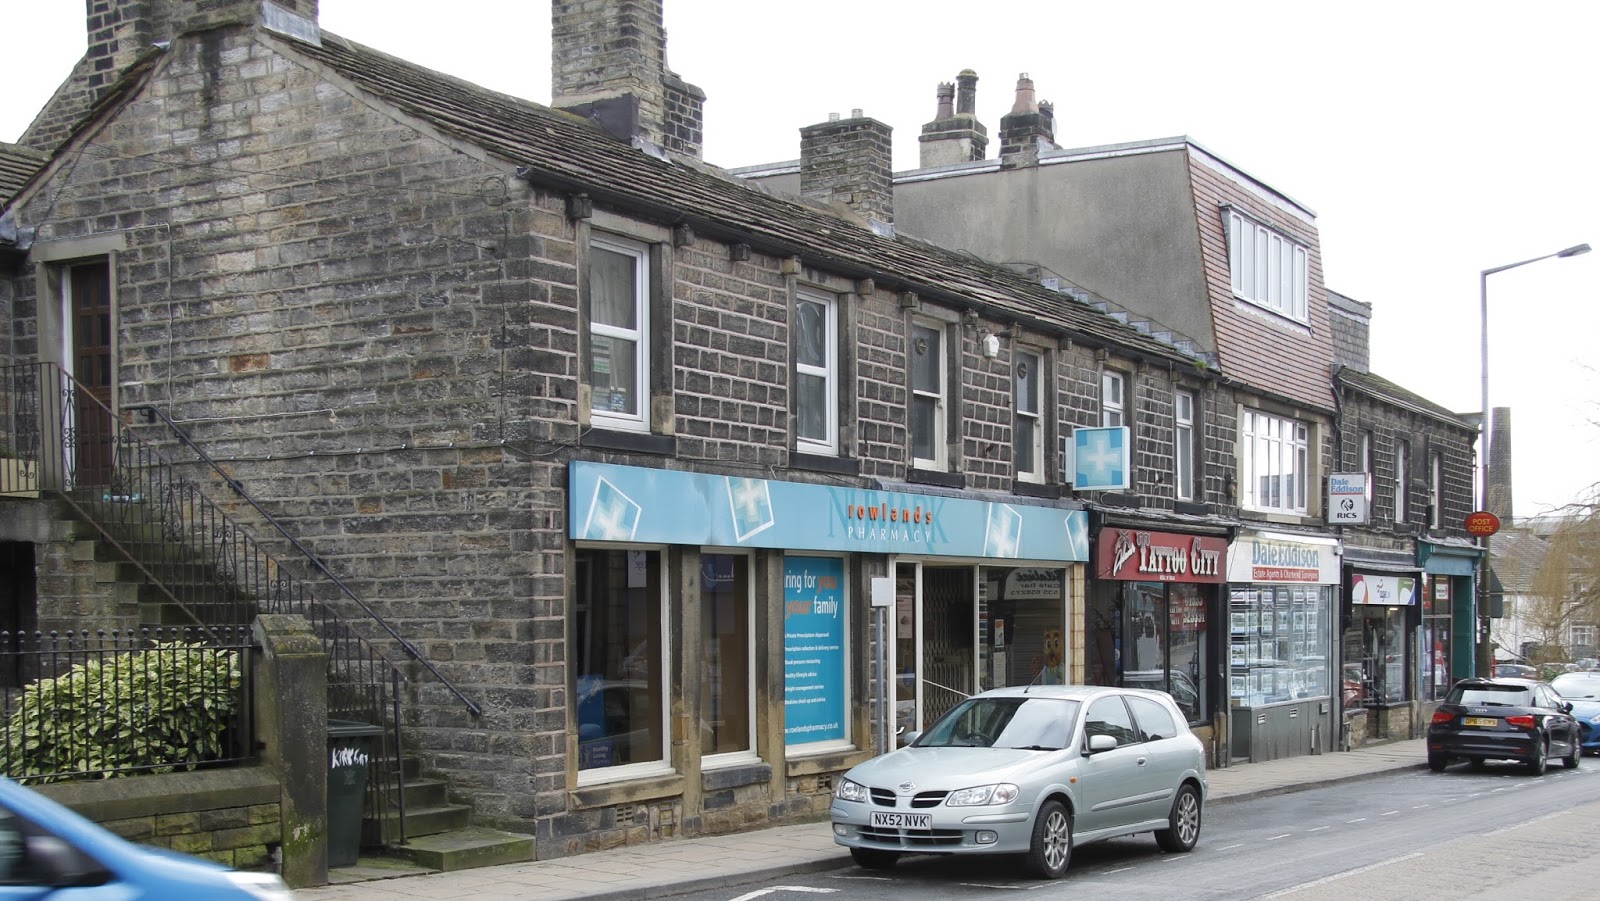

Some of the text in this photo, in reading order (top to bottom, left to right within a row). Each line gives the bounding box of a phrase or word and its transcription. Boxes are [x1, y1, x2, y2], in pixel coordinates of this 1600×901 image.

[1331, 477, 1349, 485] Dale
[848, 502, 932, 525] rowlands
[1472, 518, 1491, 526] POST
[848, 526, 931, 543] PHARMACY
[784, 569, 838, 594] ring for you
[1253, 569, 1266, 578] Estate
[1267, 570, 1280, 580] Agents
[1284, 570, 1301, 579] Chartered
[785, 595, 838, 619] your family
[874, 813, 927, 828] NX52 NVK
